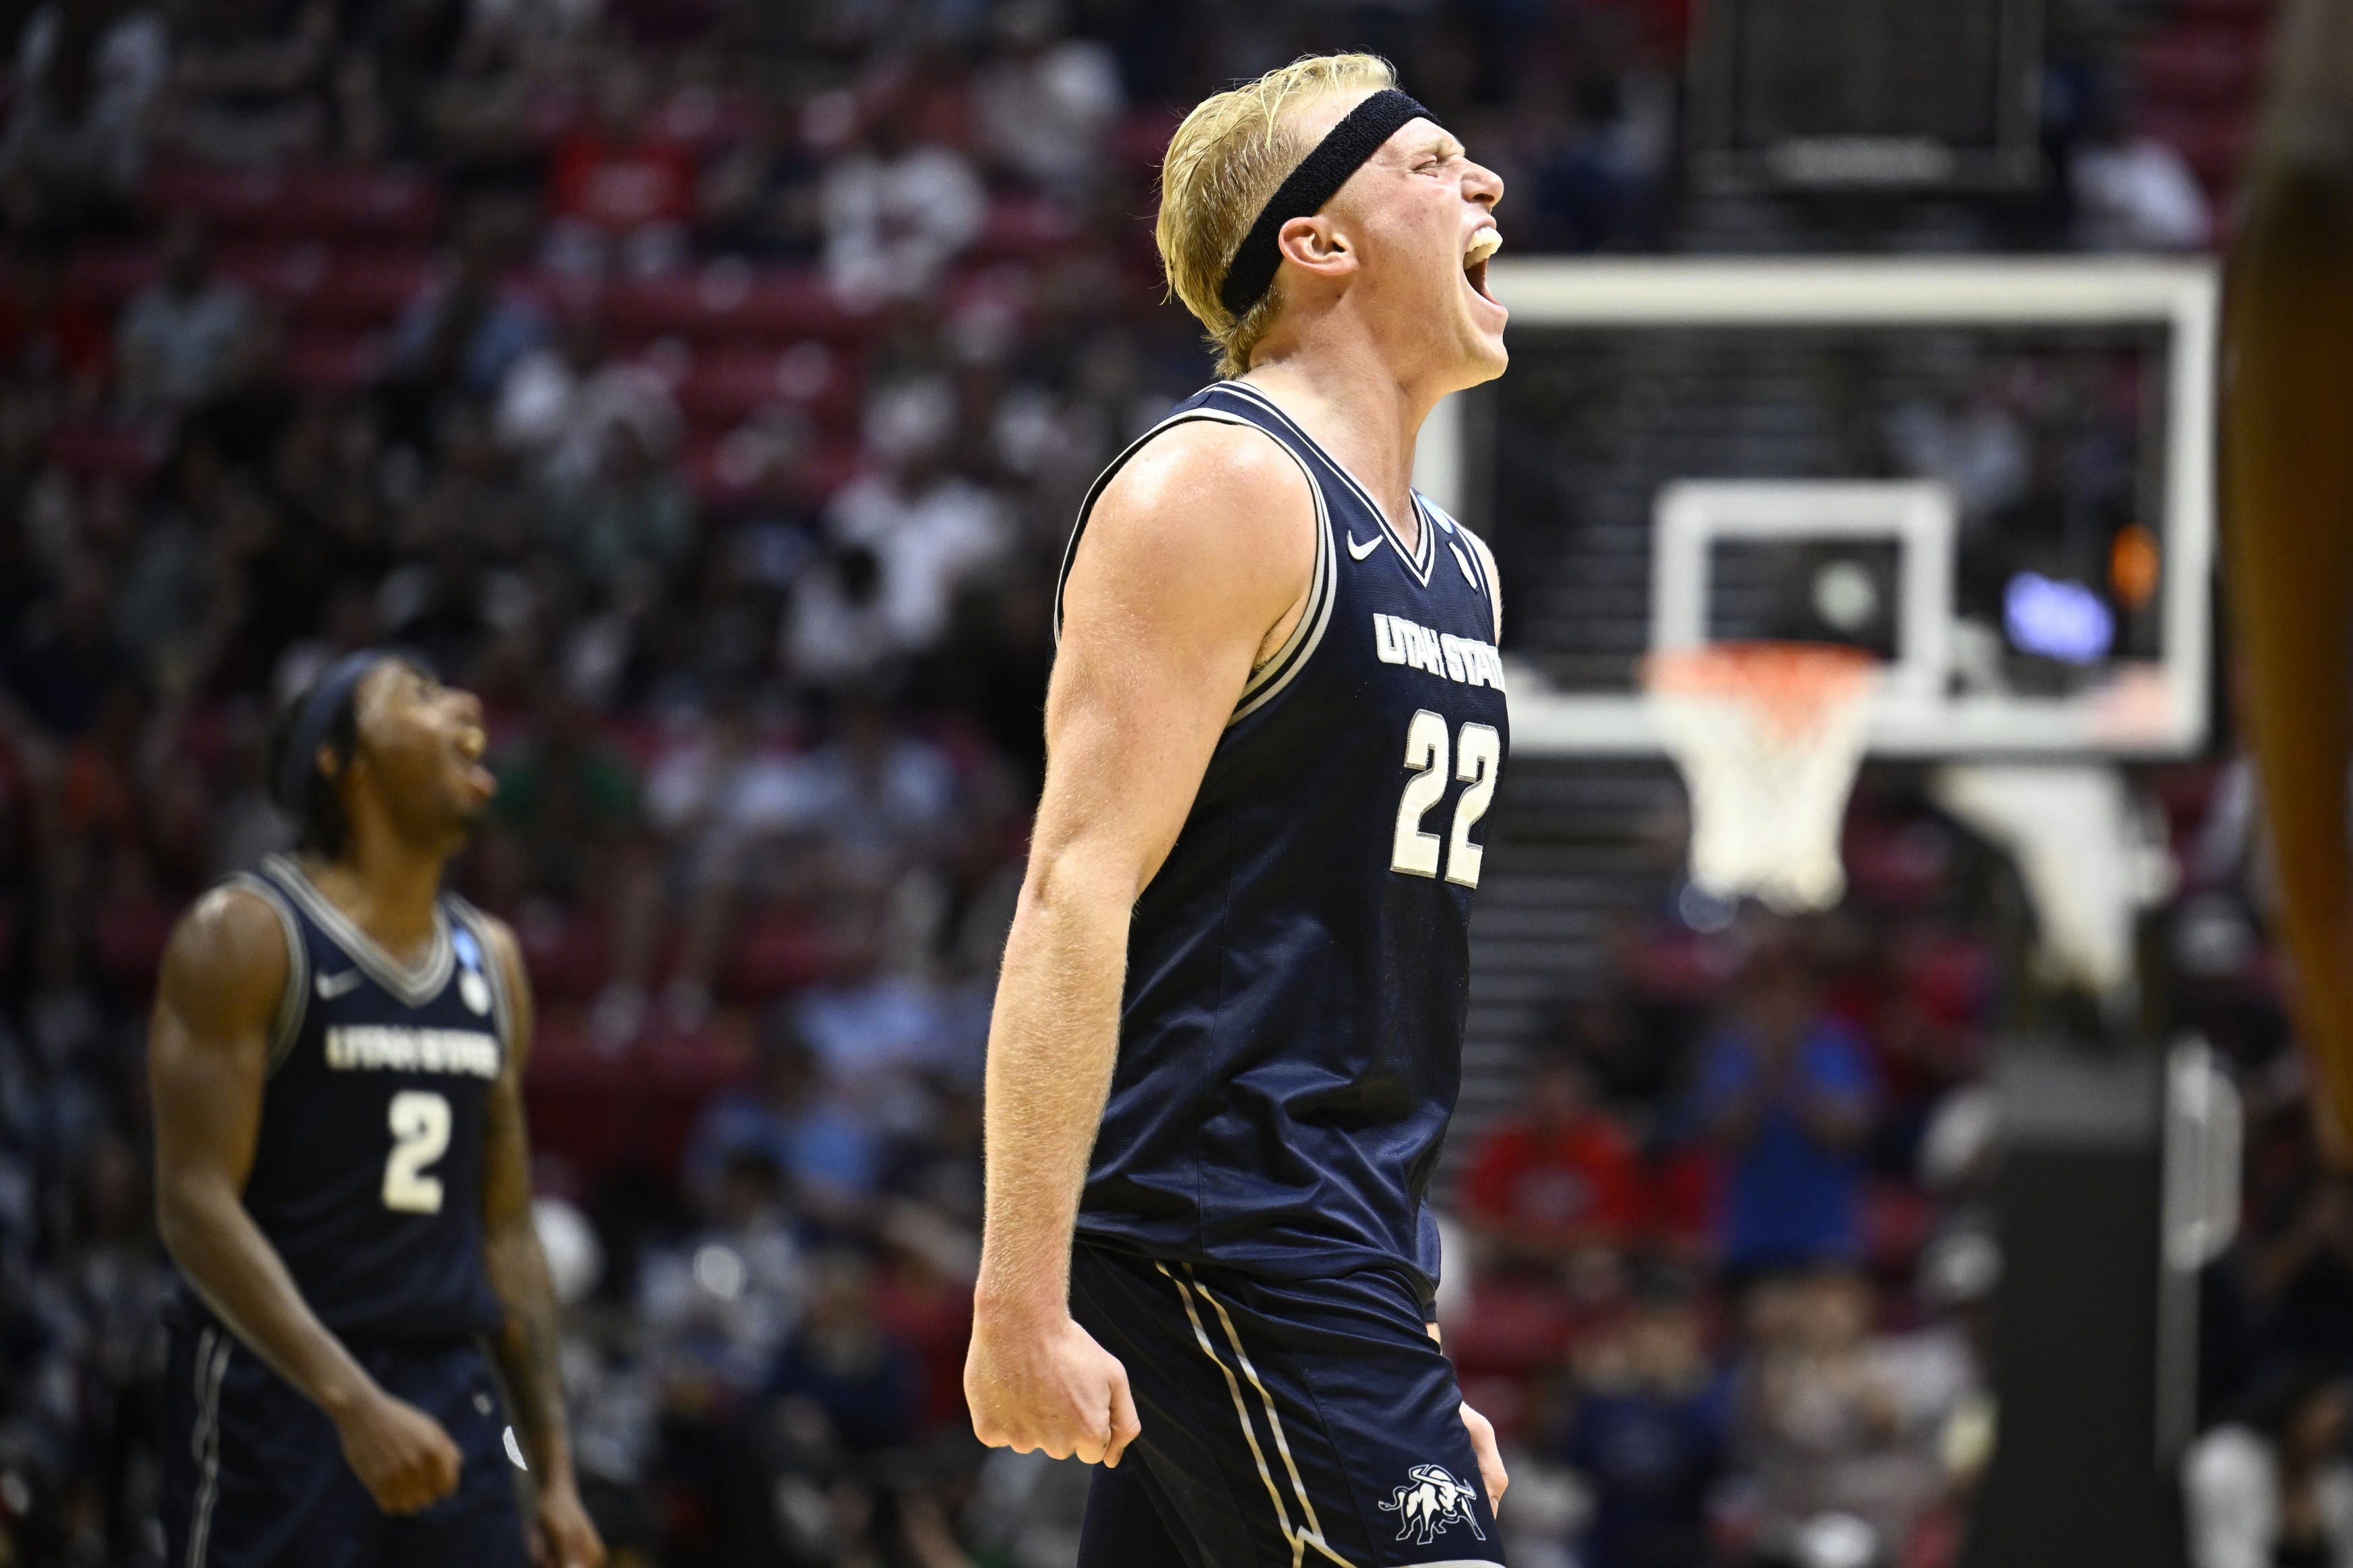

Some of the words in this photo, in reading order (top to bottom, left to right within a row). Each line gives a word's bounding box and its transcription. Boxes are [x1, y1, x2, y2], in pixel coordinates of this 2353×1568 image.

[1374, 613, 1447, 679] UTAH
[1390, 709, 1500, 888] 22
[325, 1024, 417, 1072] UTAH
[381, 1090, 452, 1214] 2
